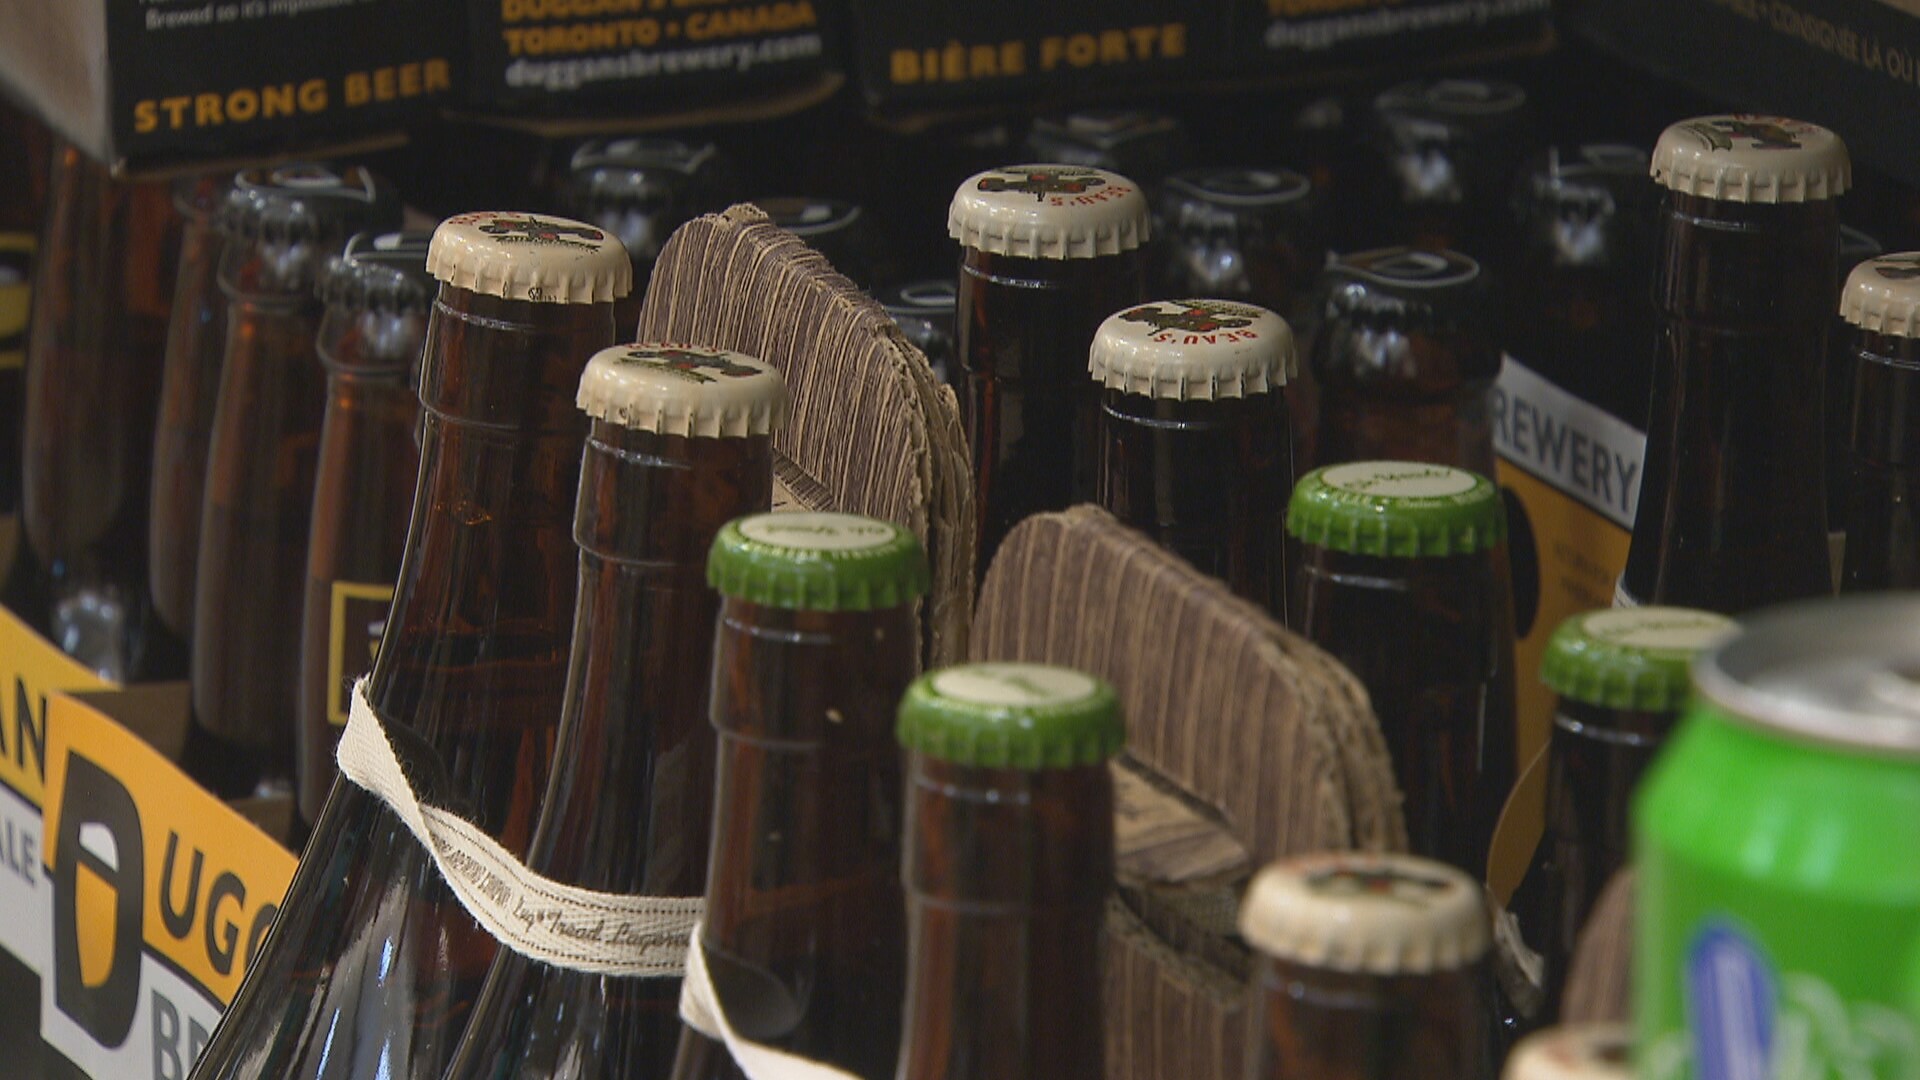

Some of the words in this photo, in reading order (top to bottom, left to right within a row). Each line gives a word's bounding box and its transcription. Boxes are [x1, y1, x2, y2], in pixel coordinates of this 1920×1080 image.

[145, 3, 213, 31] Brewed
[216, 4, 240, 23] so
[502, 18, 660, 57] TORONTO
[685, 3, 818, 40] CANADA
[505, 34, 822, 91] duggansbrewery.com
[1040, 22, 1186, 72] FORTE
[133, 79, 328, 133] STRONG
[344, 58, 449, 107] BEER
[1153, 329, 1259, 345] BEAU'S
[0, 677, 47, 785] N
[0, 819, 37, 889] LE
